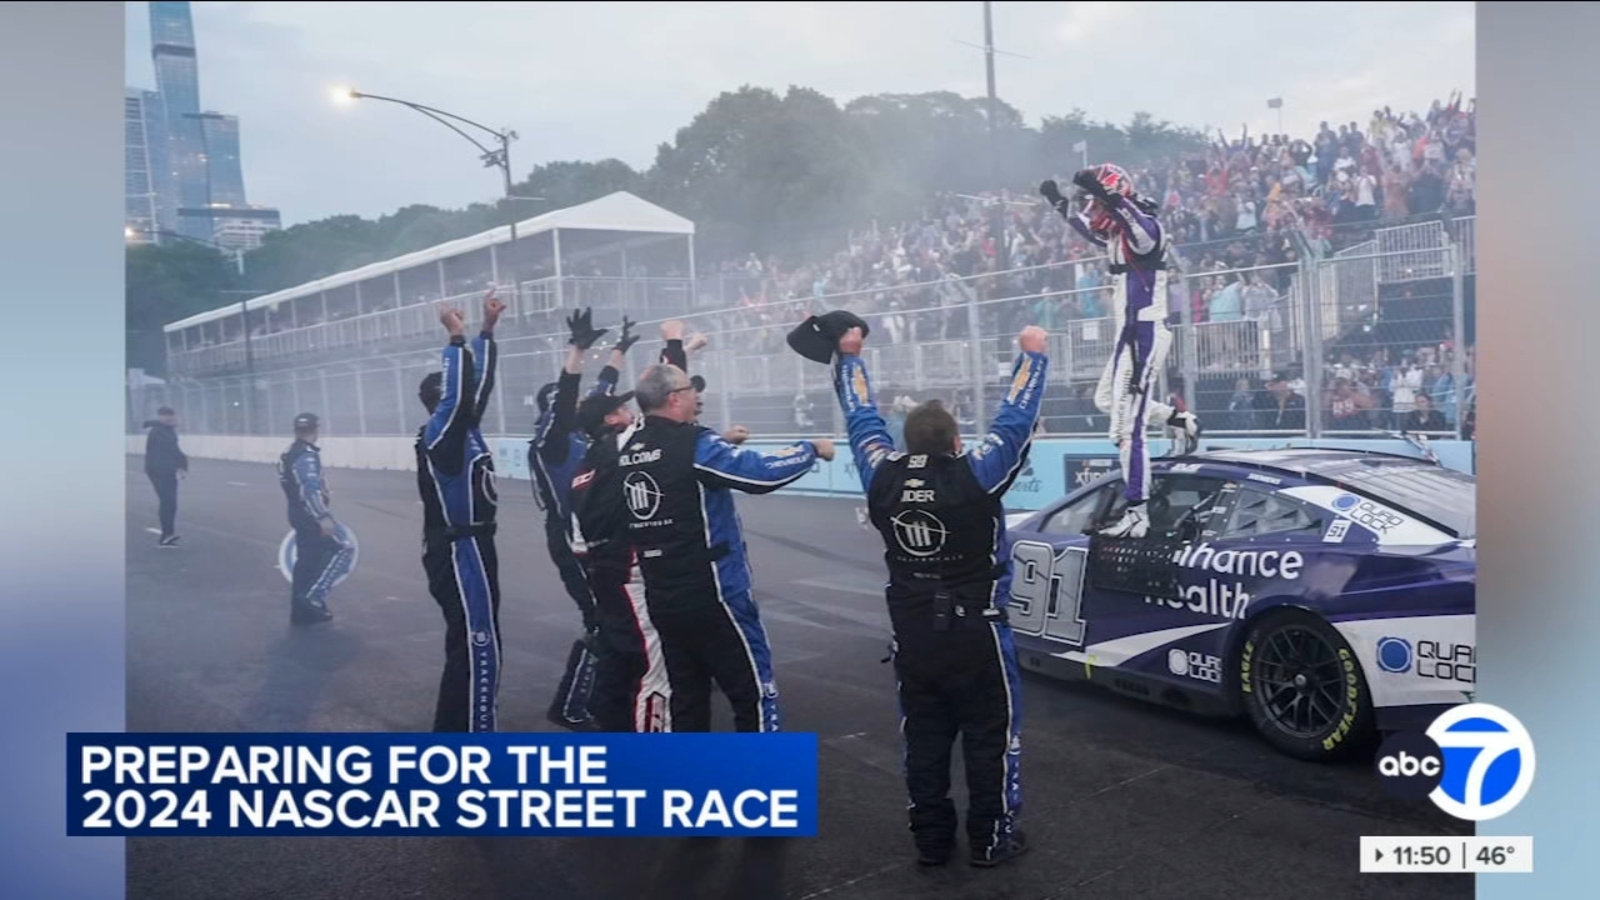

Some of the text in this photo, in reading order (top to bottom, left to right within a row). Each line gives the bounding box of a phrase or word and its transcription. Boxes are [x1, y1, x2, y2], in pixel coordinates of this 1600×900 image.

[1350, 508, 1395, 535] LOCK
[1360, 501, 1405, 526] QUAD
[1006, 540, 1089, 647] 91
[1417, 640, 1476, 664] QUA
[1190, 666, 1222, 683] LOC
[1241, 640, 1254, 693] EAGLE
[1416, 659, 1476, 684] LOC
[1322, 648, 1358, 751] GOODYEAR
